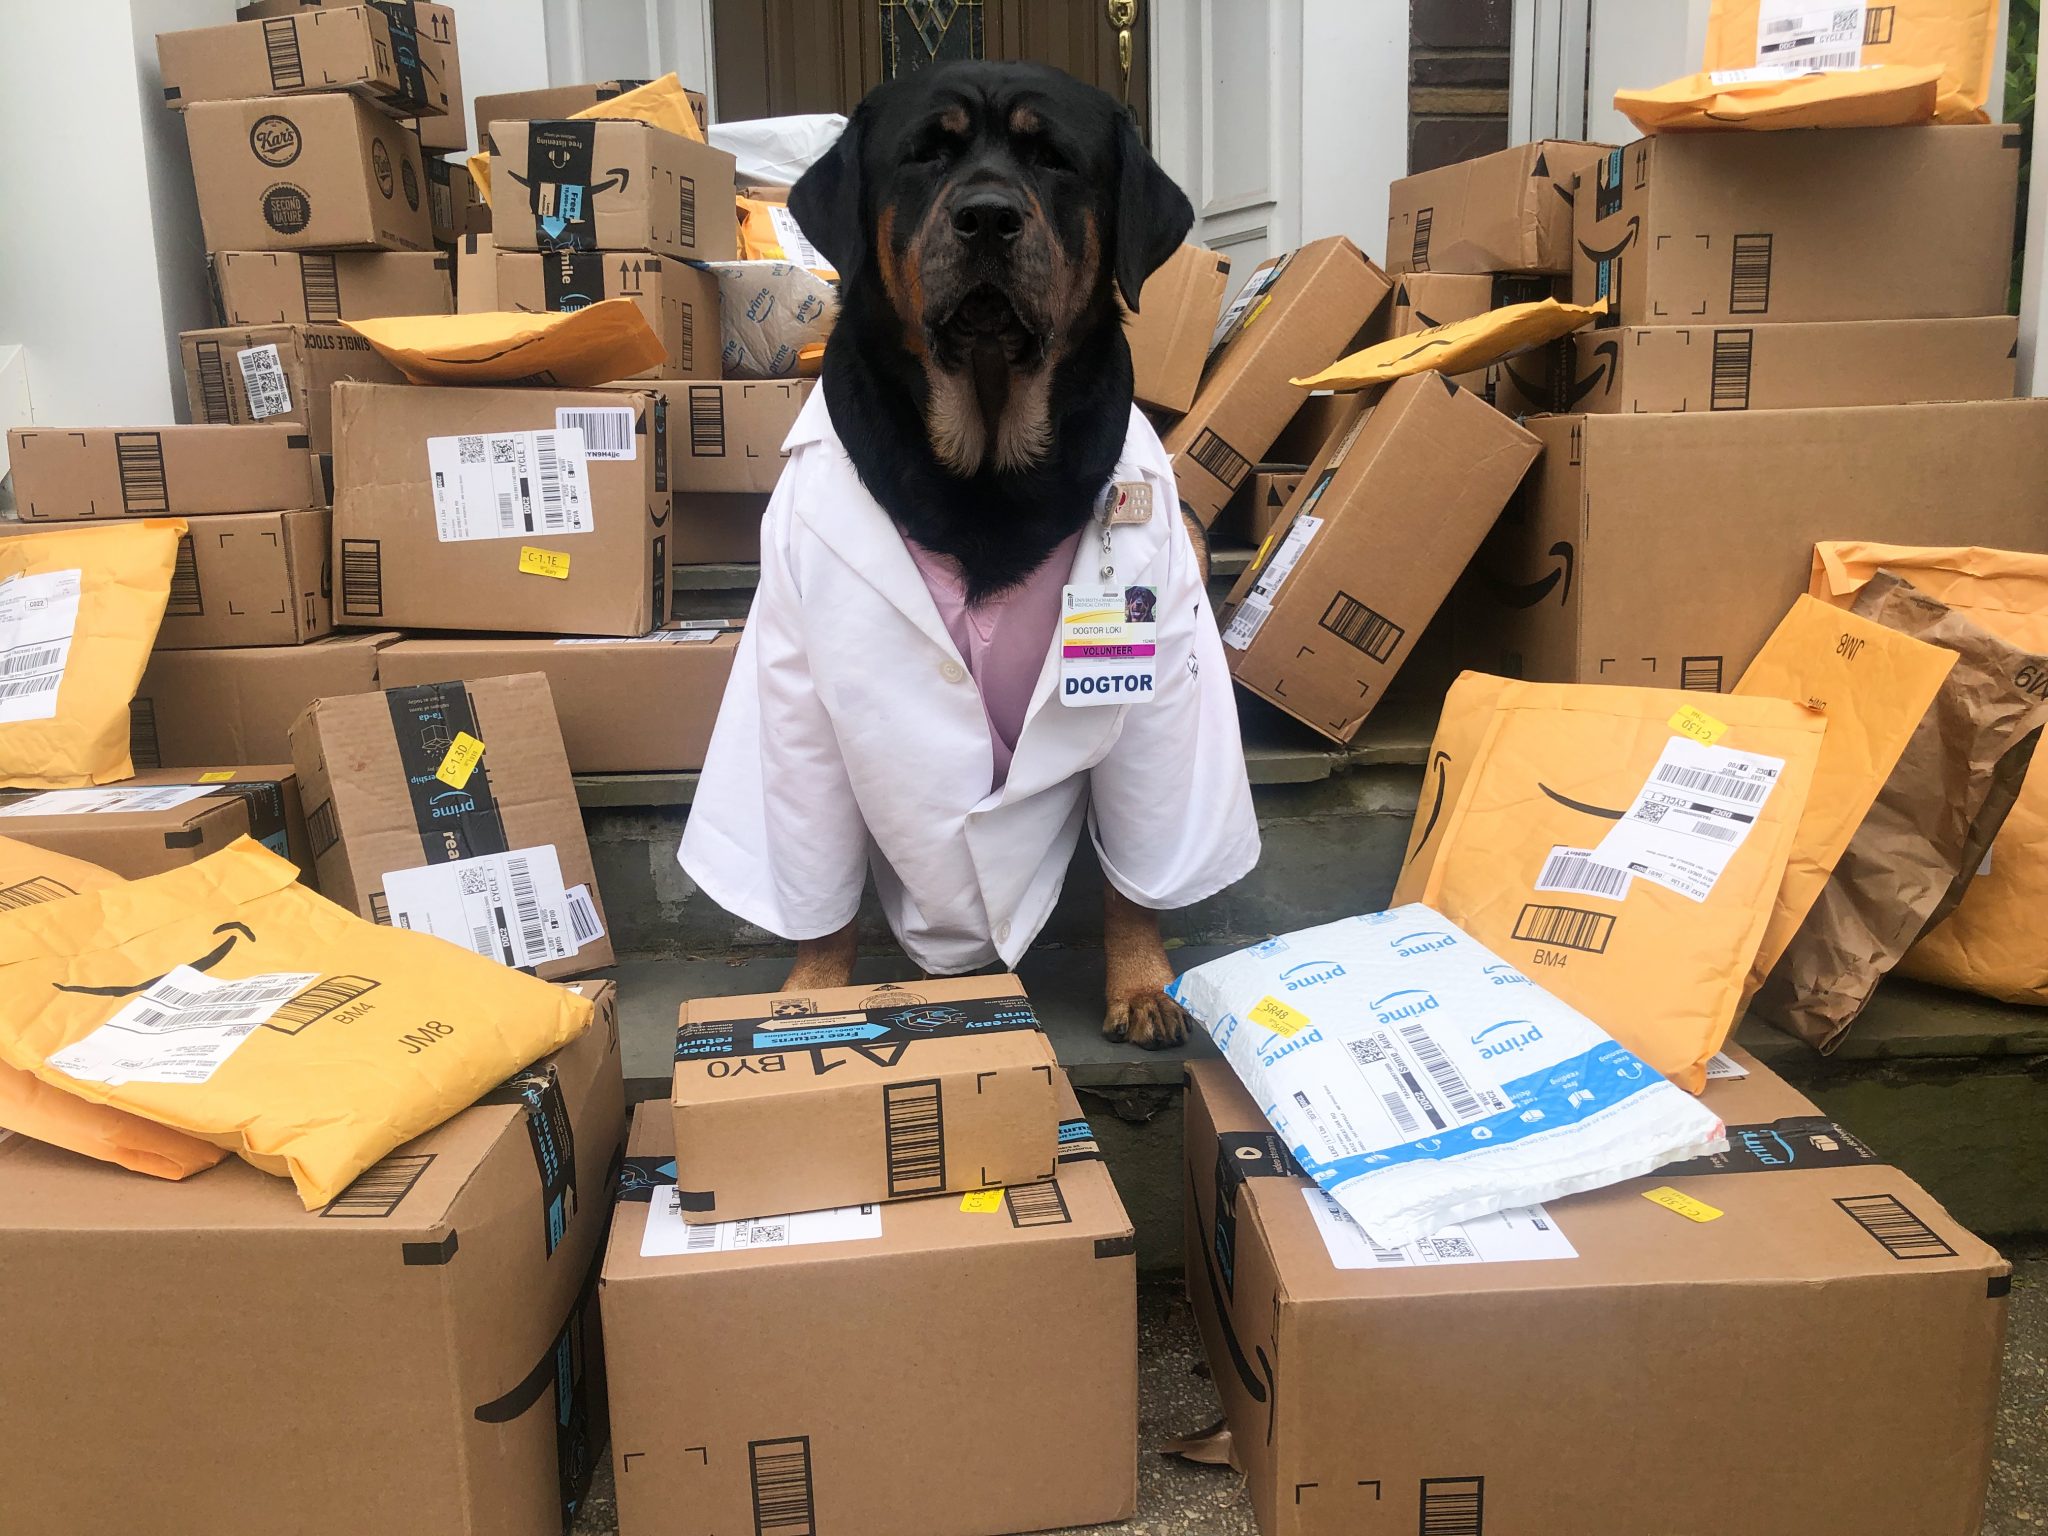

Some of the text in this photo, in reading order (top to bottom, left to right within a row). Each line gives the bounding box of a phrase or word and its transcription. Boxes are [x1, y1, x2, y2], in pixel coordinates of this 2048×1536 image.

[1819, 34, 1844, 44] CYCLE
[536, 136, 582, 149] free listening
[271, 198, 300, 211] SECOND
[272, 211, 302, 223] NATURE
[561, 252, 571, 284] mile
[746, 287, 769, 322] prime
[796, 294, 816, 324] prime
[304, 334, 370, 351] SINGLE STOCK
[770, 344, 789, 376] prime
[520, 449, 528, 473] CYCLE
[523, 496, 531, 514] DDC2
[528, 552, 558, 566] C-1.1E
[1072, 626, 1122, 635] DOGTOR LOKI
[1083, 646, 1133, 655] VOLUNTEER
[1836, 633, 1865, 661] JM8
[1065, 674, 1153, 695] DOGTOR
[418, 712, 444, 721] Ta-da
[1681, 720, 1712, 740] C-1.3D
[445, 744, 468, 776] C-1.3D
[432, 798, 475, 818] prime
[1661, 792, 1686, 807] CYCLE
[1711, 808, 1732, 818] DDC2
[491, 878, 501, 902] CYCLE
[500, 927, 509, 947] DDC2
[1399, 936, 1458, 958] prime
[1532, 949, 1567, 968] BM4
[1287, 964, 1347, 991] prime
[333, 1002, 376, 1024] BM4
[1263, 1002, 1289, 1020] SR48
[1379, 994, 1440, 1024] prime
[965, 1018, 1036, 1029] per-easy
[398, 1020, 454, 1054] JM8
[772, 1031, 858, 1044] Free returns
[1478, 1025, 1543, 1060] prime
[1264, 1028, 1323, 1068] prime
[1378, 1033, 1408, 1072] Same Auto
[707, 1054, 786, 1078] BYO
[1612, 1054, 1630, 1064] free
[1550, 1070, 1580, 1086] reading
[1562, 1081, 1578, 1089] free
[1414, 1090, 1432, 1111] DDC2
[540, 1112, 559, 1176] returns
[1831, 1122, 1871, 1159] free delivery
[1265, 1135, 1284, 1174] video streaming
[1328, 1144, 1339, 1158] LEX2
[1660, 1196, 1700, 1217] C-1.3D
